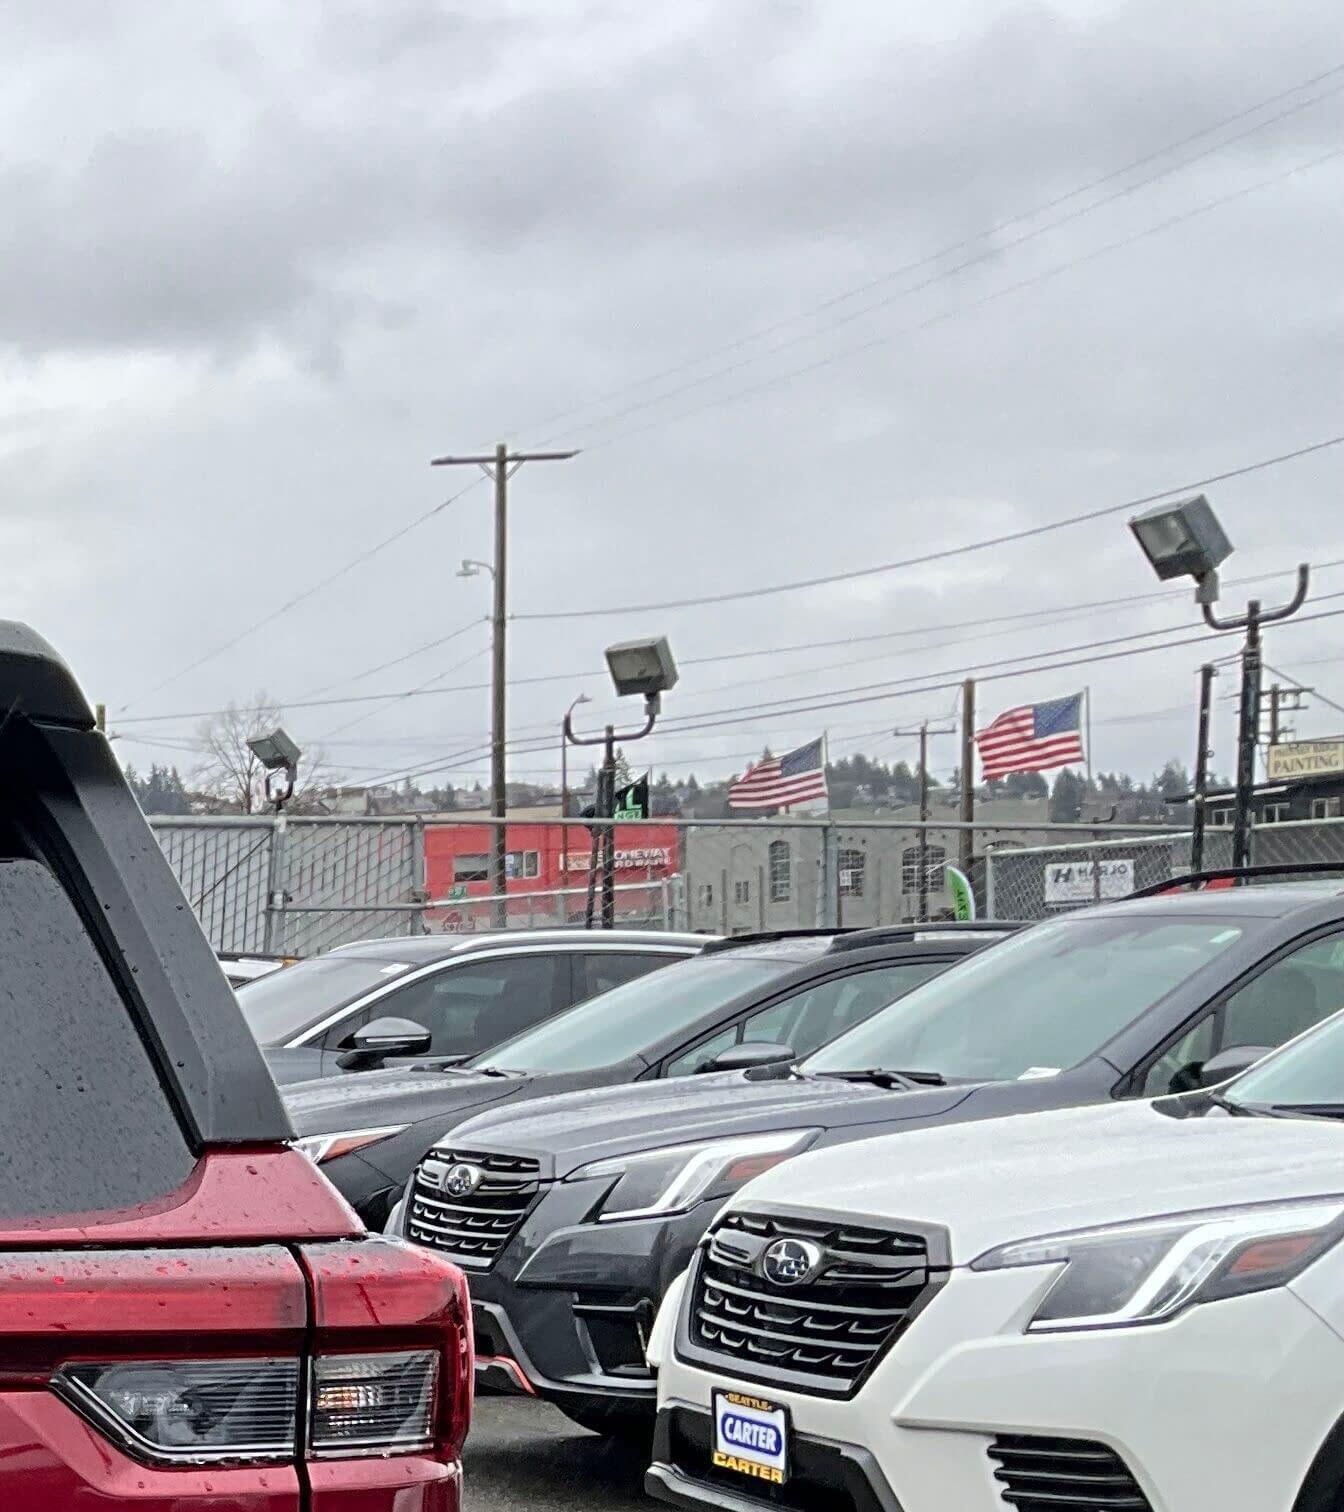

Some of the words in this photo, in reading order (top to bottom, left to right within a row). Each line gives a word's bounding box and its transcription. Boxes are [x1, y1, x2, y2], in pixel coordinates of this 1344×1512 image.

[1273, 752, 1339, 774] PAINTING
[728, 1393, 770, 1411] SEATTLE
[724, 1416, 777, 1452] CARTER
[713, 1451, 783, 1484] CARTER
